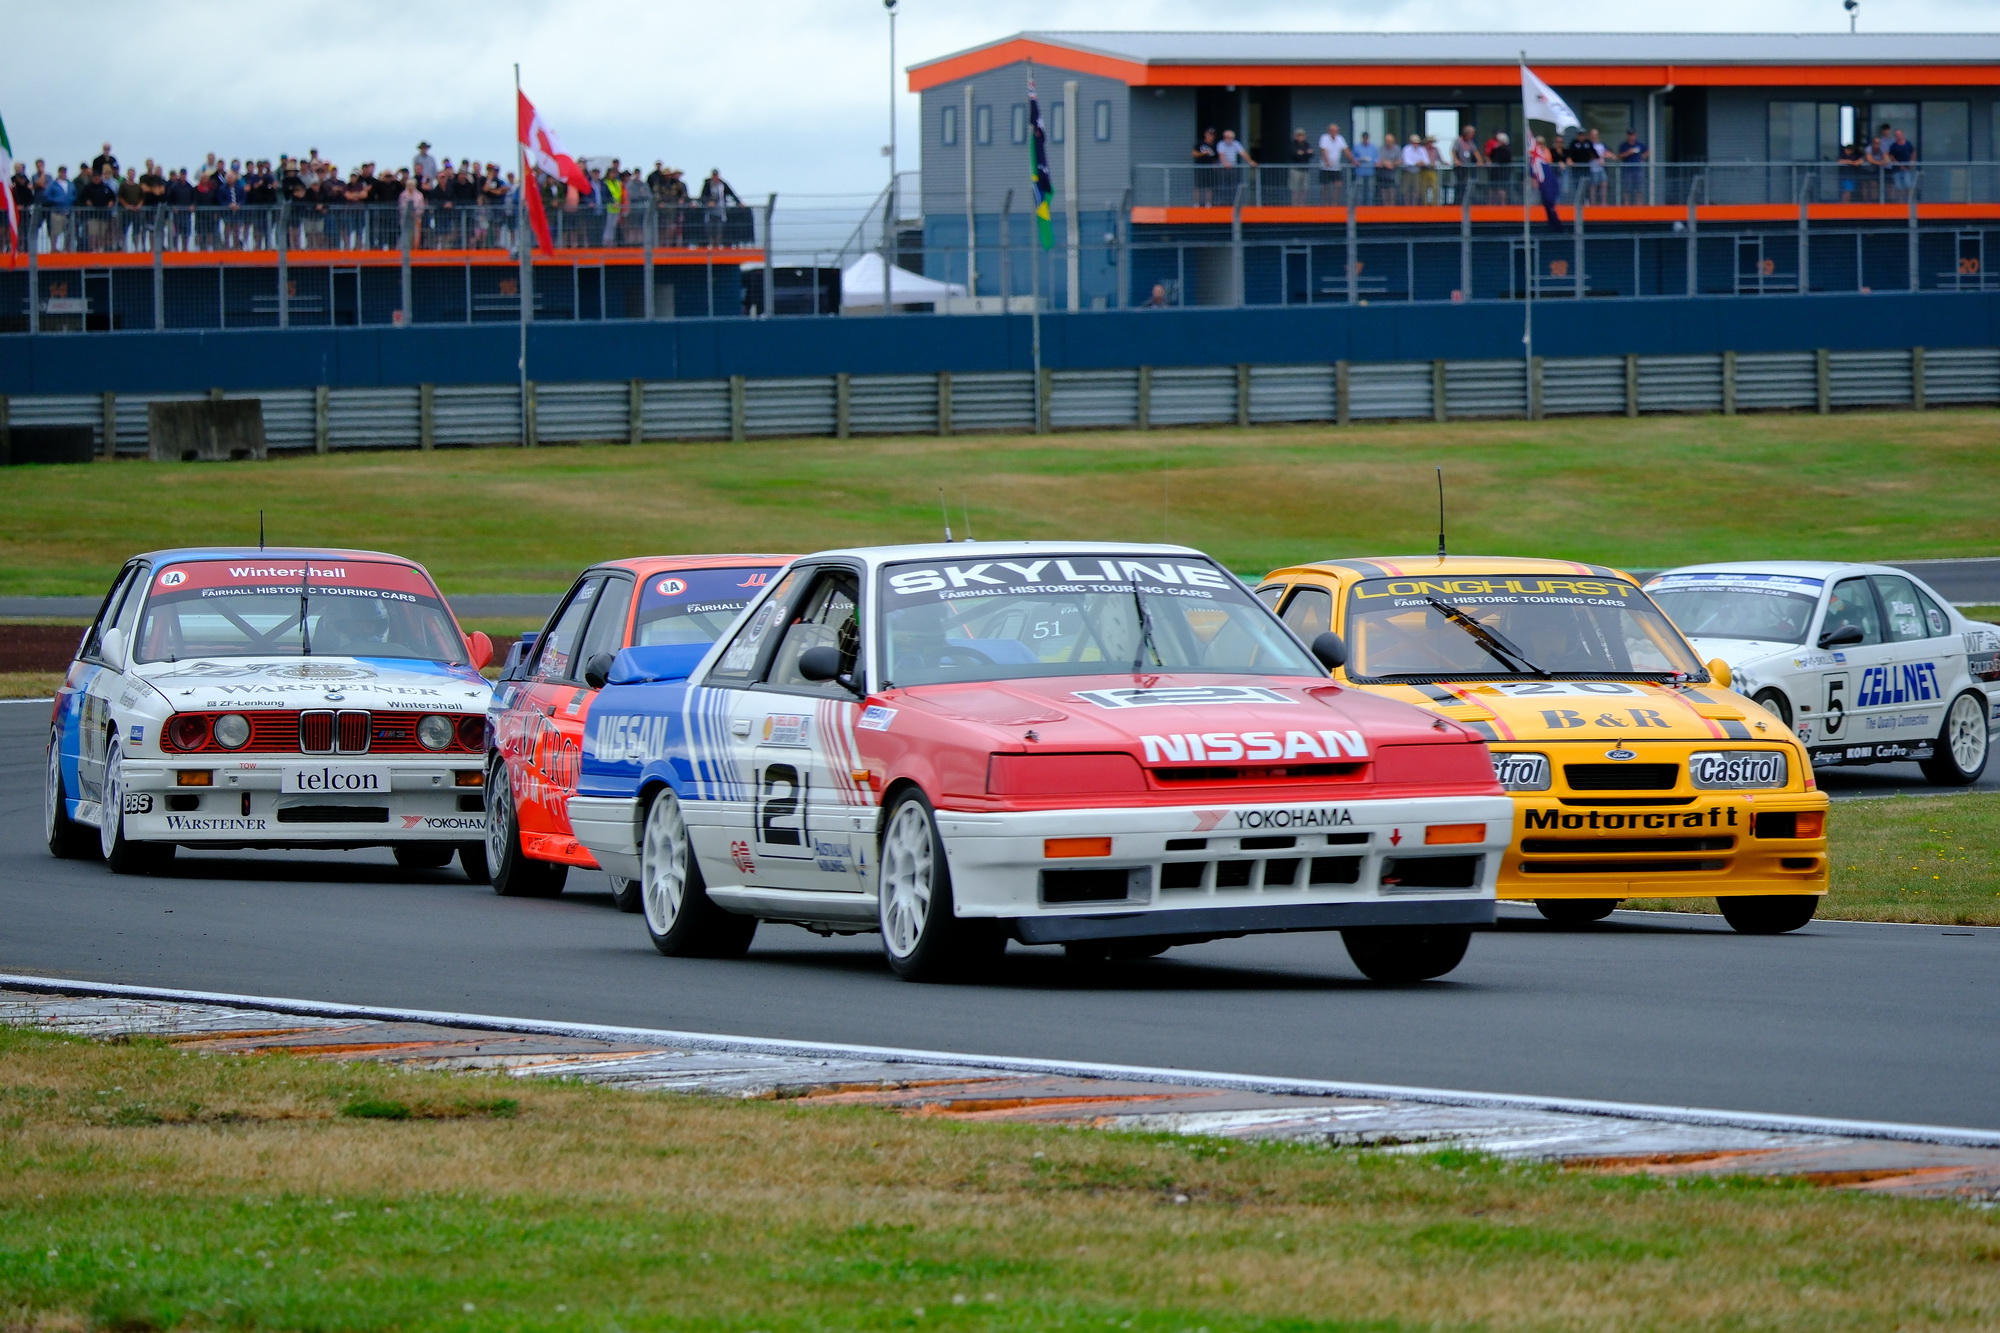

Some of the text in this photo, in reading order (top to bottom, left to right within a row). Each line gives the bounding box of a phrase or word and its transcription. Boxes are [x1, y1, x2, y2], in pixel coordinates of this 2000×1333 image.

[170, 573, 181, 584] A
[229, 567, 346, 578] Wintershall
[889, 560, 1231, 595] SKYLINE
[670, 581, 681, 592] A
[938, 584, 1214, 600] FAIRHALL HISTORIC TOURNG CARS
[1354, 581, 1635, 599] LONGHURST
[1726, 586, 1762, 594] TOURING
[1765, 589, 1789, 597] CARS
[202, 587, 417, 603] FAIRHALL HISTORC TOURING CARS
[1452, 596, 1519, 604] HISTORIC
[1520, 596, 1585, 604] TOURING
[1587, 598, 1626, 607] CARS
[687, 602, 744, 613] FAIRHALL
[1032, 620, 1063, 639] 51
[217, 684, 442, 697] WARSTEINER
[1500, 682, 1633, 695] 20
[1857, 662, 1941, 707] CELLNET
[219, 700, 285, 708] ZF-Lenkung
[387, 701, 463, 710] Wintershall
[1825, 680, 1844, 734] 5
[595, 715, 669, 760] NISSAN
[1139, 730, 1369, 762] NISSAN
[1846, 746, 1872, 759] KONI
[1875, 744, 1907, 758] CarPro
[1493, 758, 1543, 784] strol
[1699, 755, 1779, 783] Castrol
[296, 767, 379, 790] telcon
[166, 815, 266, 830] WARSTEINER
[424, 818, 488, 829] YOKOHAM
[1235, 808, 1353, 829] YOKOHAMA
[1524, 807, 1738, 830] Motorcraft
